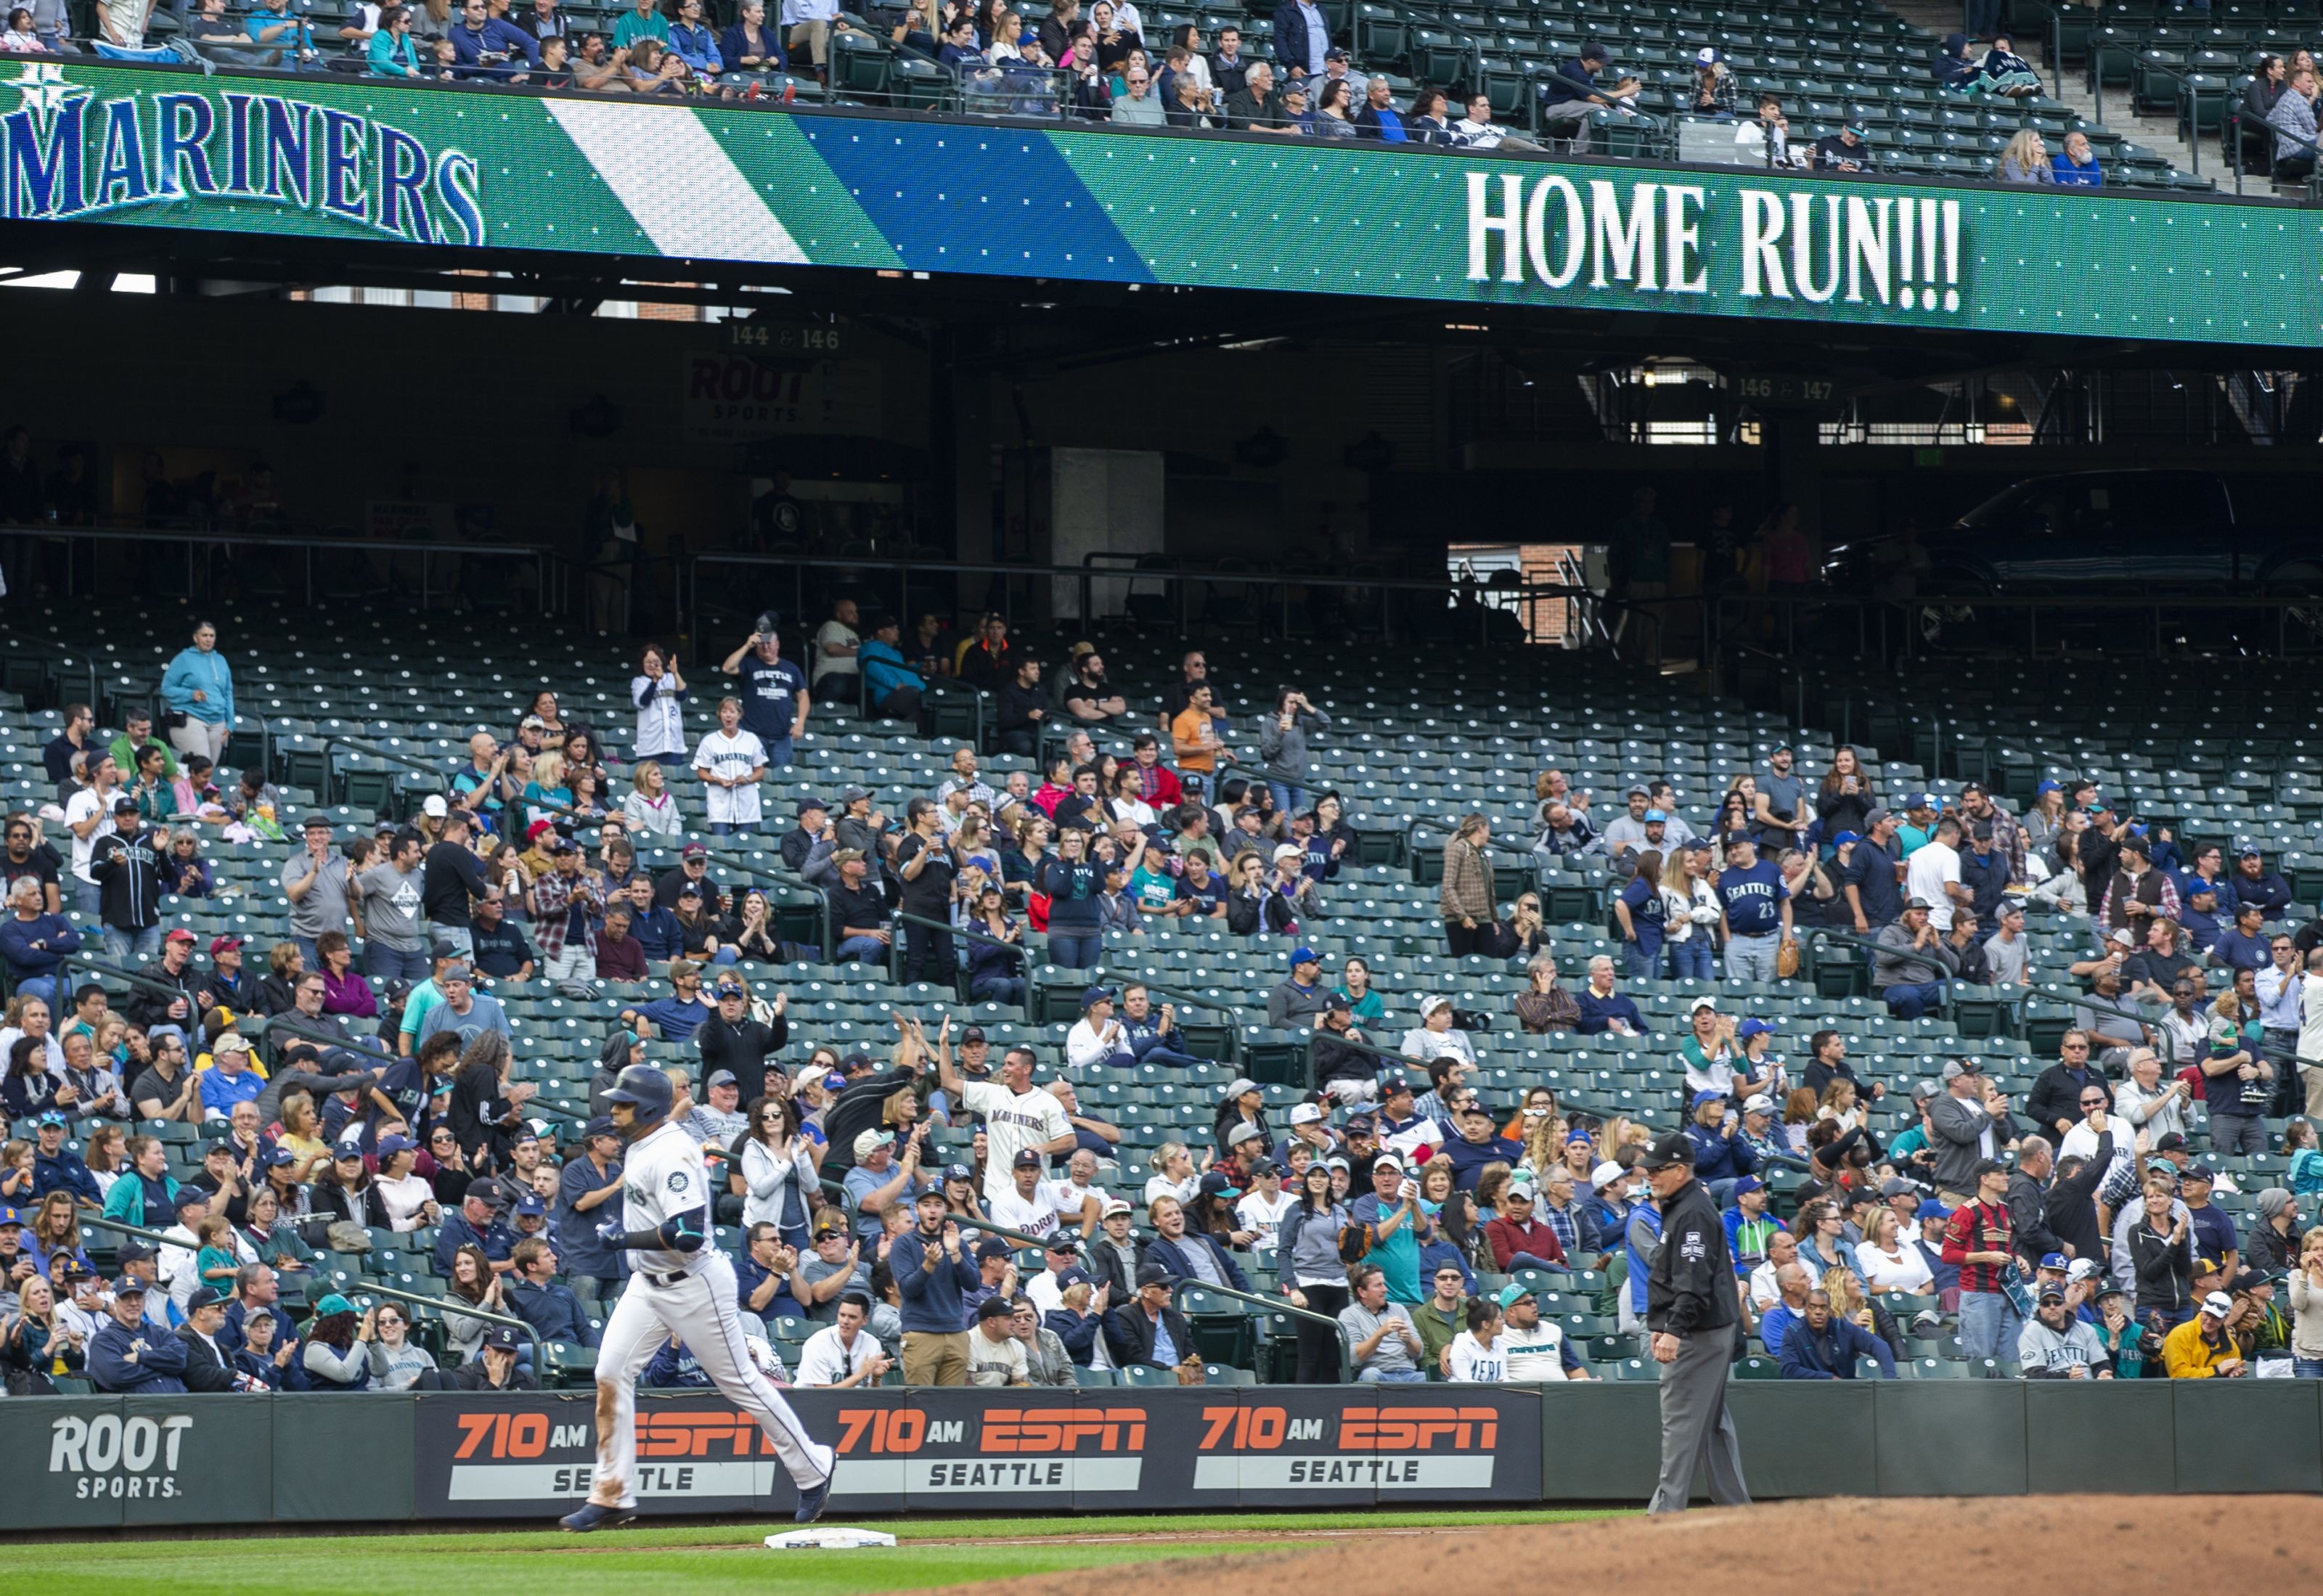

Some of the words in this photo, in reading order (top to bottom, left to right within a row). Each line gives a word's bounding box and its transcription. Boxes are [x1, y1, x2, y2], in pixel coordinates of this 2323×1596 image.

[1, 91, 486, 247] MARINERS
[1466, 172, 1709, 294] HOME
[1739, 189, 1961, 314] RUN!!!
[731, 326, 769, 345] 144
[802, 329, 839, 350] 146
[690, 359, 815, 404] ROOT
[1739, 378, 1771, 398] 146
[1803, 381, 1833, 401] 147
[713, 405, 797, 422] SPORTS
[713, 752, 754, 764] MARINERS
[1726, 882, 1773, 903] SEATTLE
[1758, 902, 1775, 919] 23
[990, 1109, 1045, 1132] MARINERS
[927, 1183, 936, 1192] S
[2100, 1280, 2109, 1290] S
[503, 1330, 511, 1342] S
[1507, 1343, 1556, 1355] MARINERS
[454, 1412, 549, 1459] 710
[550, 1424, 588, 1449] AM
[834, 1409, 926, 1454] 710
[926, 1420, 963, 1444] AM
[980, 1408, 1147, 1452] ESPN
[1199, 1407, 1287, 1450] 710
[1287, 1419, 1323, 1441] AM
[1338, 1407, 1499, 1450] ESPN
[49, 1414, 194, 1473] ROOT
[552, 1467, 694, 1493] SETLE
[928, 1462, 1063, 1486] SEATTLE
[1289, 1460, 1419, 1484] SEATTLE
[75, 1476, 176, 1499] SPORTS
